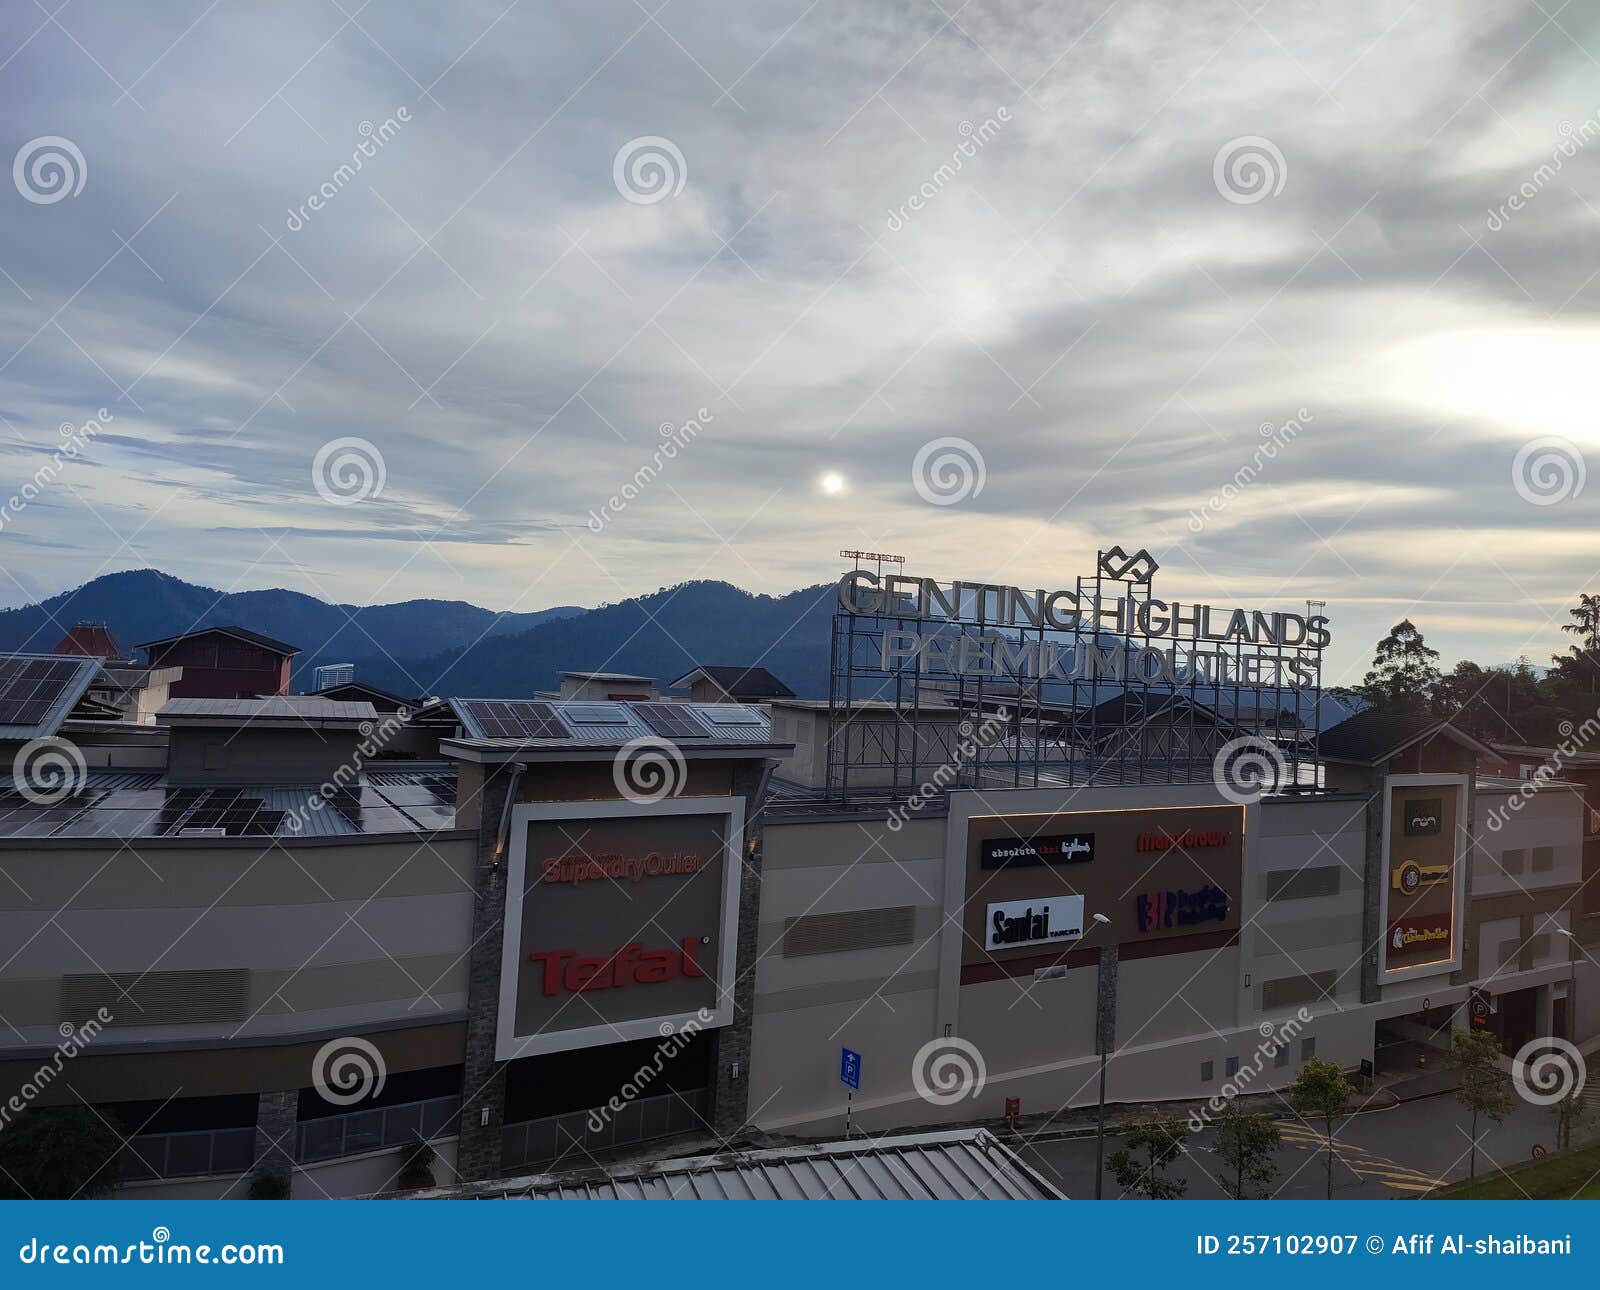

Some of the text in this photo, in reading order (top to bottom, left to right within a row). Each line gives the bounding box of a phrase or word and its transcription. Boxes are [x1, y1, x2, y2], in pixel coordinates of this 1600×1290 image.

[838, 570, 1331, 648] GENTING HIGHLANDS
[882, 630, 1315, 690] PREMIUM OUTLETS
[992, 906, 1049, 944] Santai
[530, 936, 705, 996] Tefal
